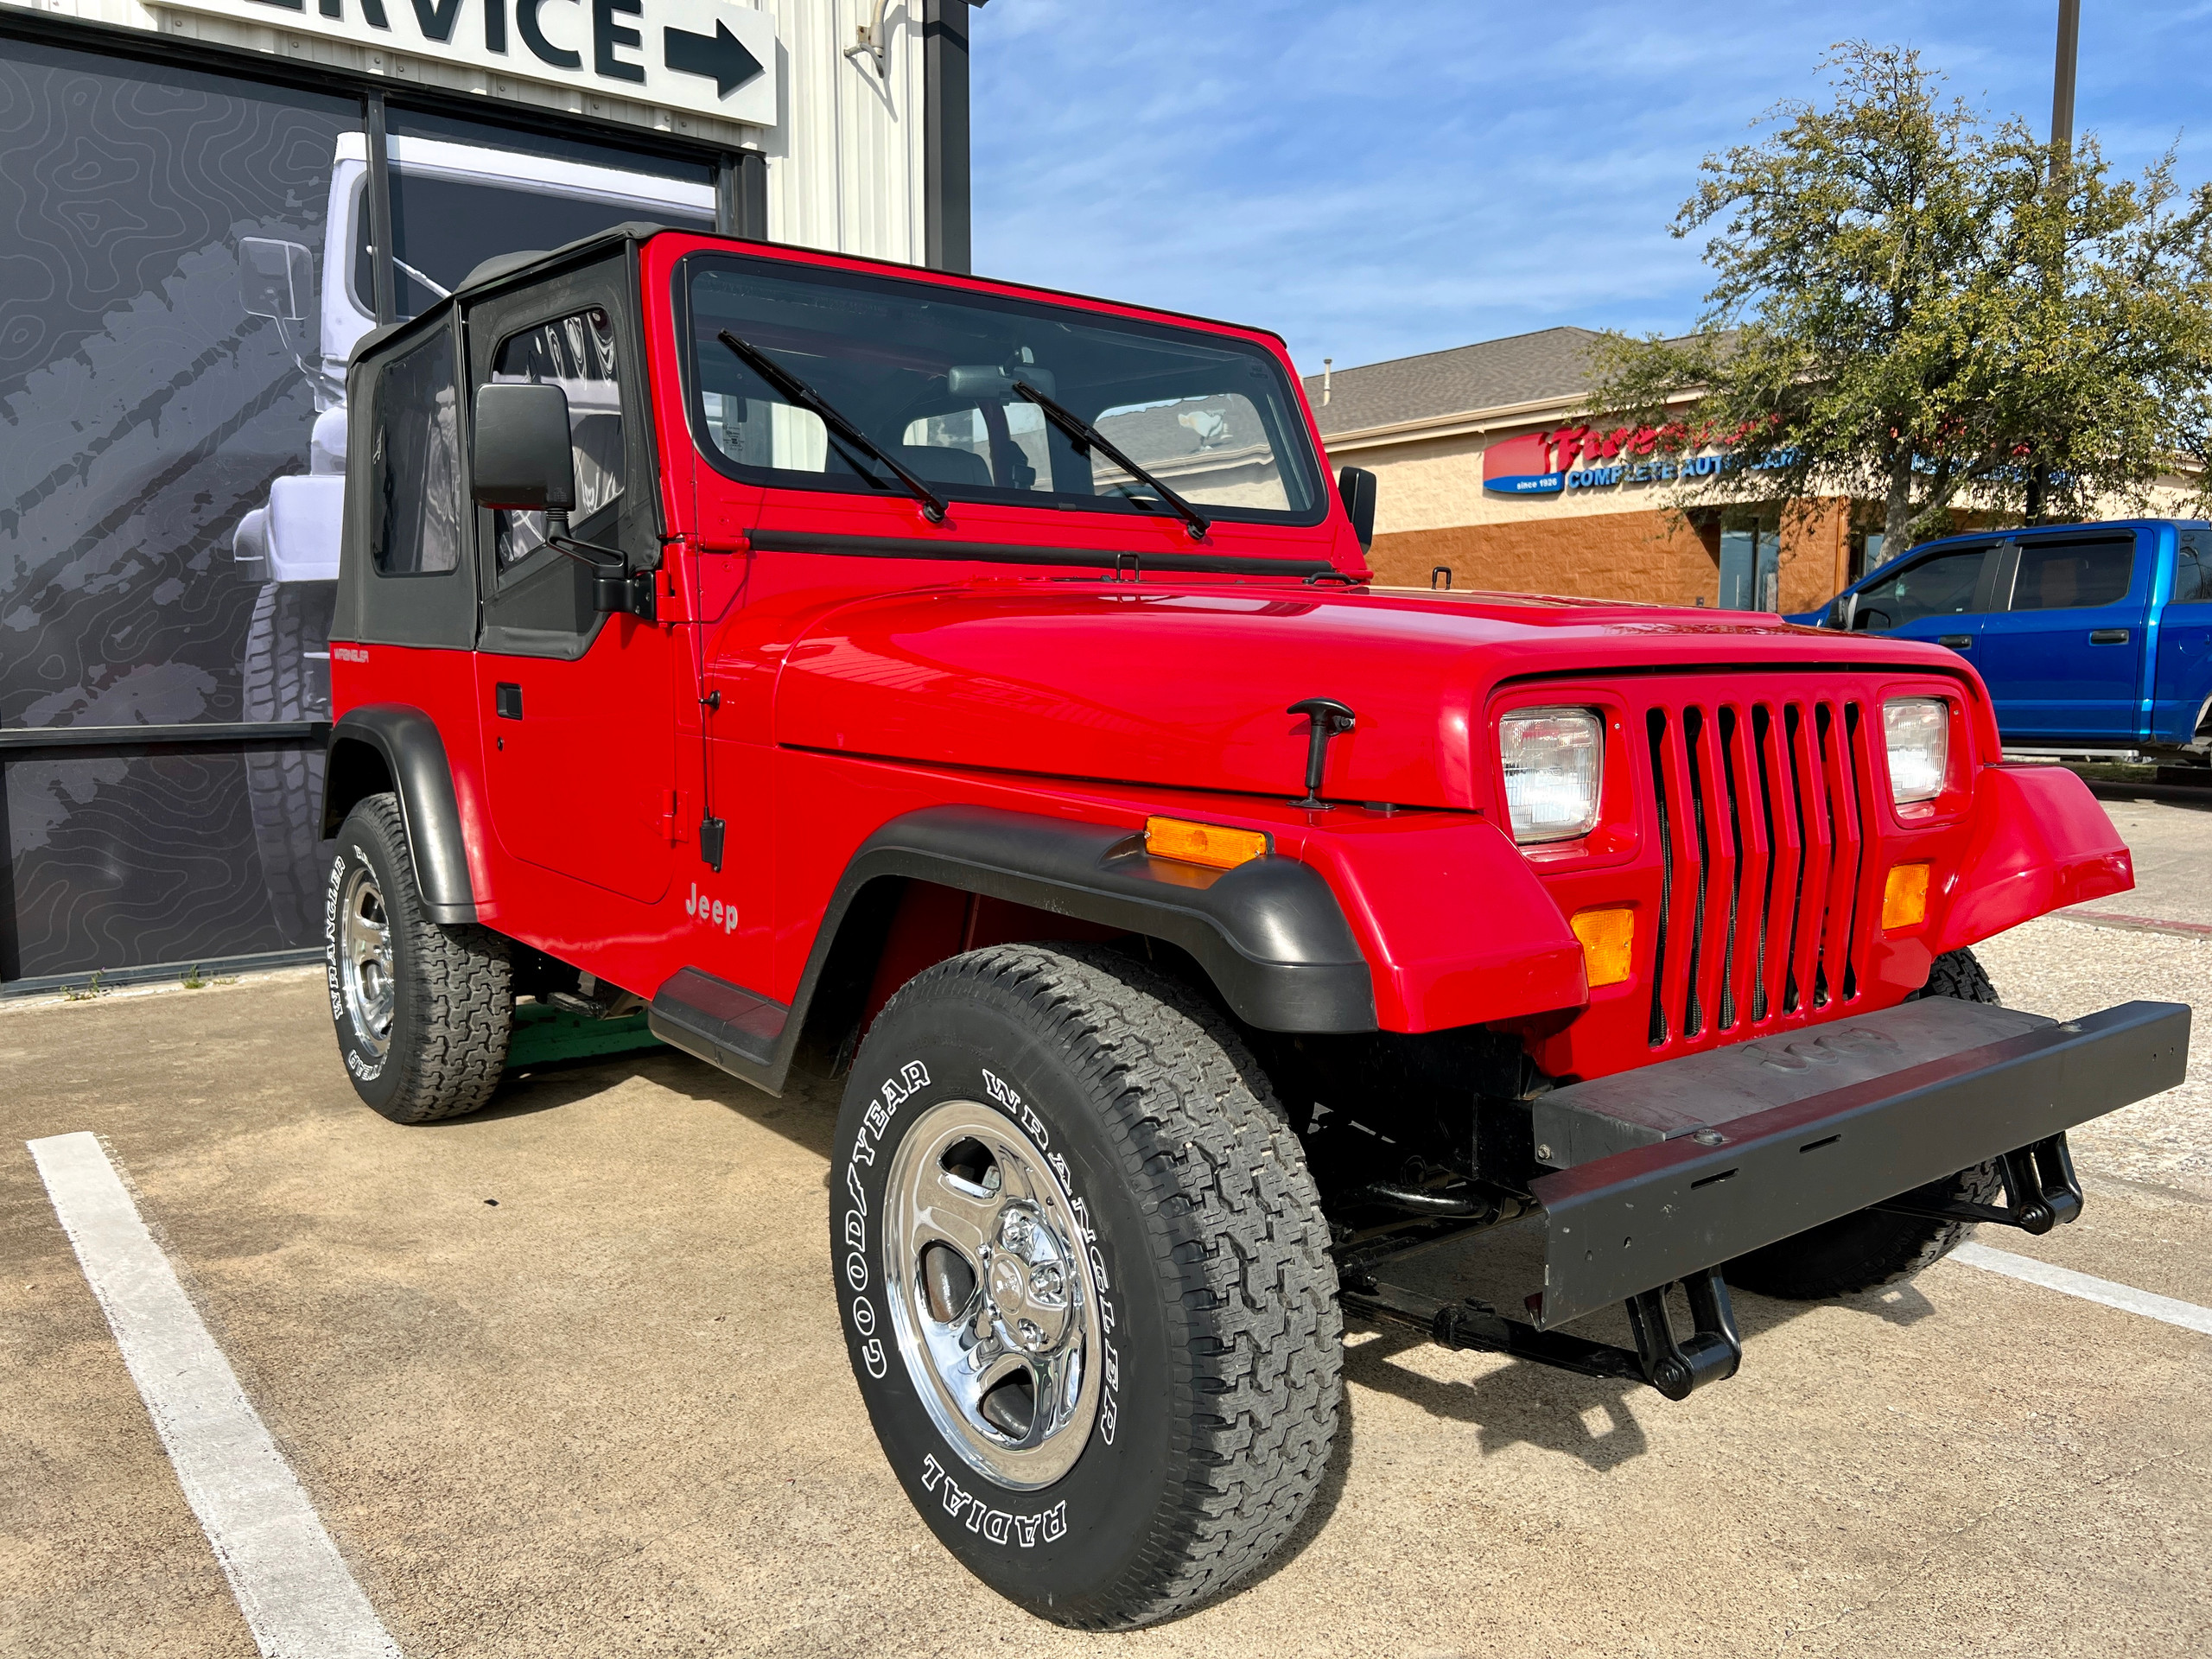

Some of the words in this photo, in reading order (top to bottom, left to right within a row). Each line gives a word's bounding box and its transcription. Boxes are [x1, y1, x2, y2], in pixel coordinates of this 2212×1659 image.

[1516, 480, 1537, 490] since
[1539, 477, 1558, 487] 1926
[324, 855, 346, 1021] WRANGLER
[685, 881, 739, 935] Jeep
[982, 1067, 1121, 1446] WRANGLER
[921, 1452, 1069, 1548] RADIAL
